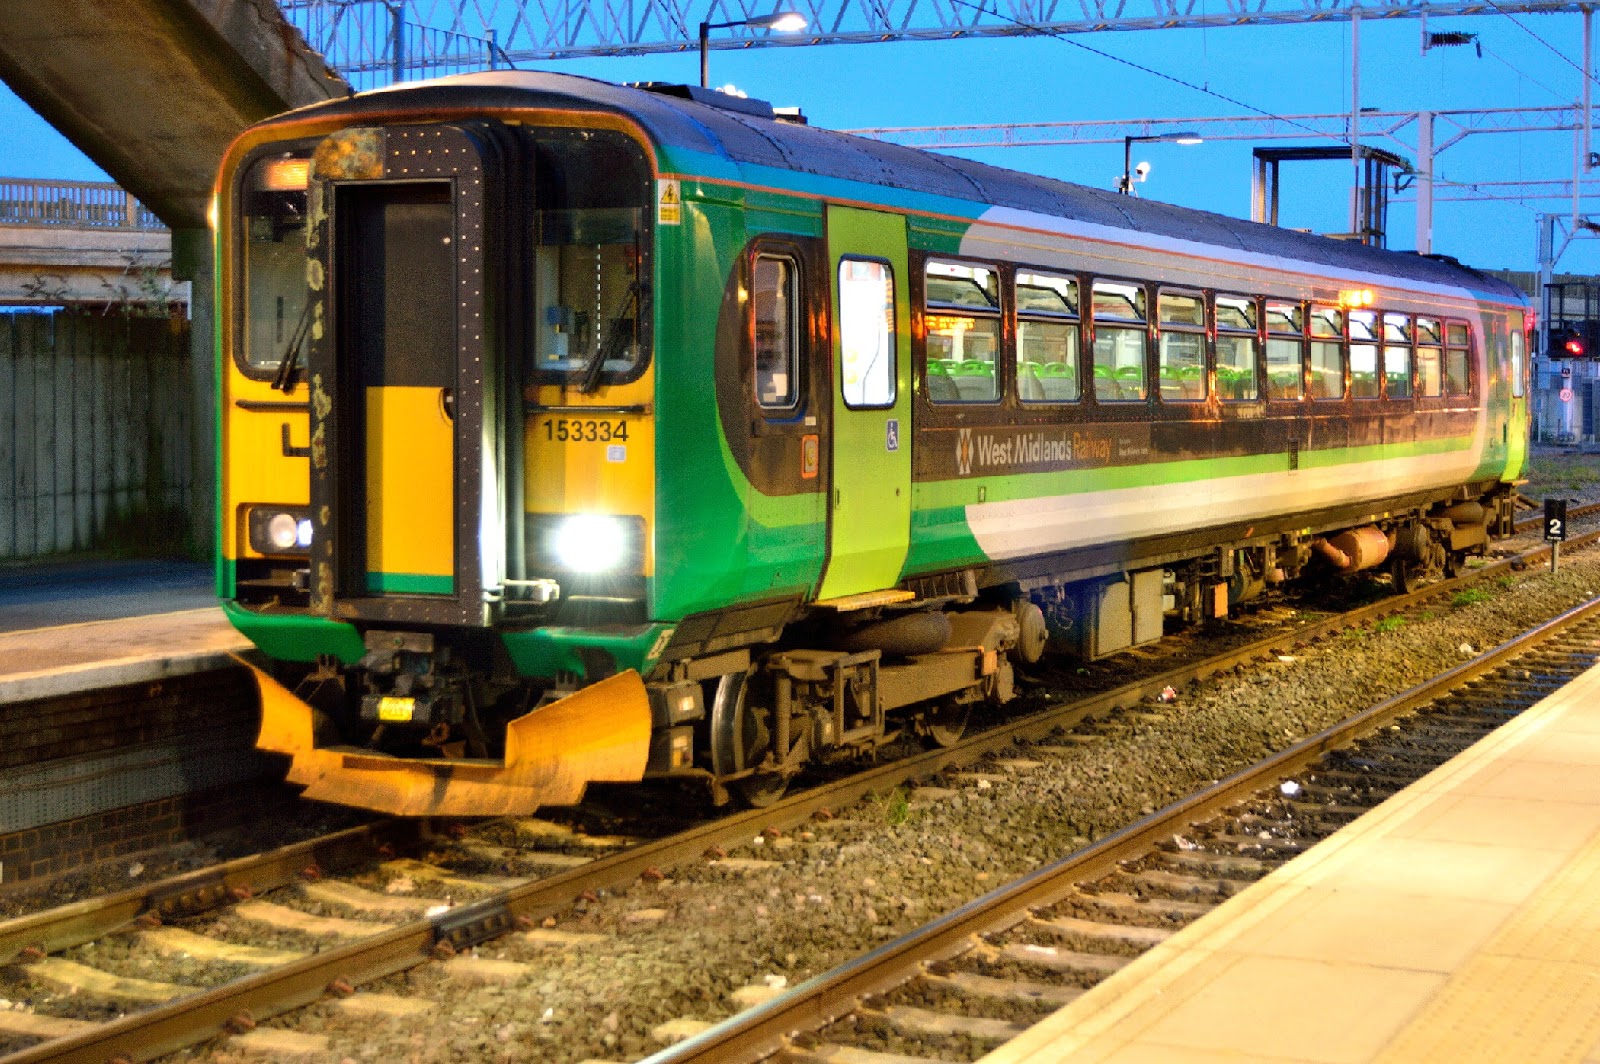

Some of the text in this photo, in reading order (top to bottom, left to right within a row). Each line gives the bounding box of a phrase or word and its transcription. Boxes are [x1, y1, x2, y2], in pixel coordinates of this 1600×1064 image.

[543, 419, 630, 442] 153334
[977, 431, 1112, 467] West Midlands Railway
[1549, 518, 1562, 535] 2
